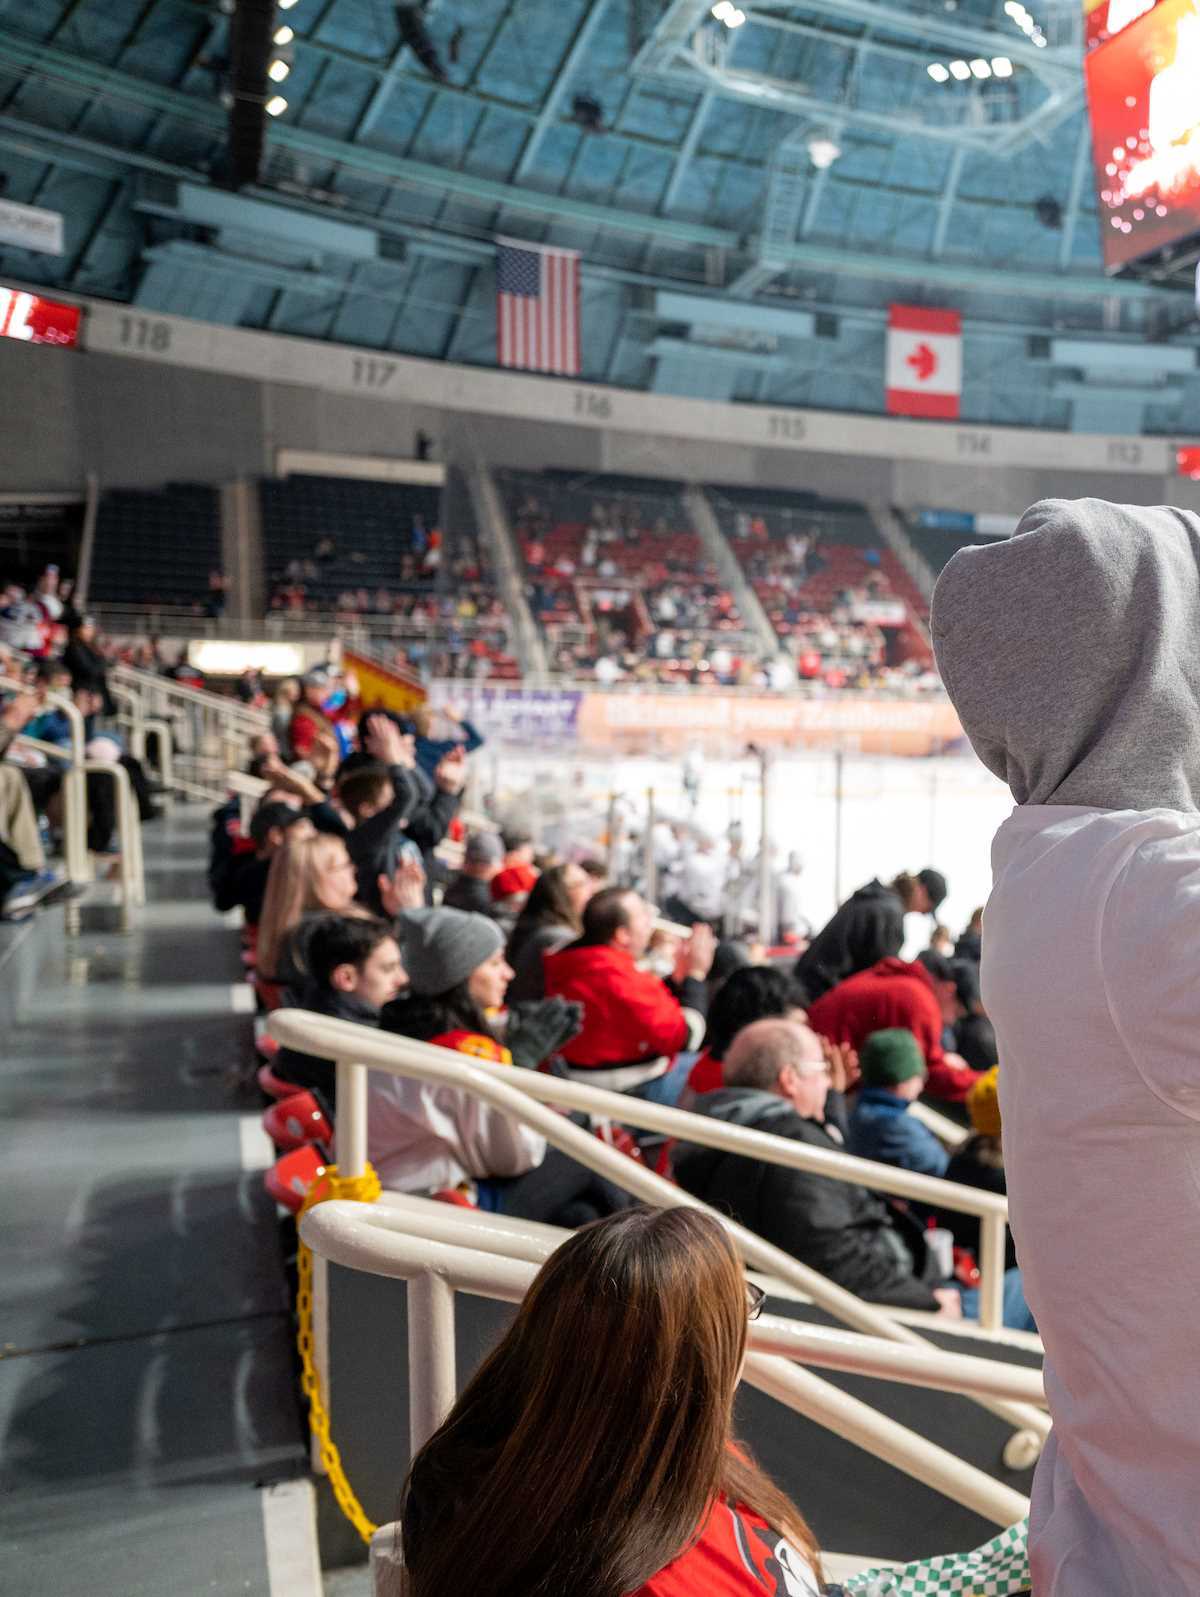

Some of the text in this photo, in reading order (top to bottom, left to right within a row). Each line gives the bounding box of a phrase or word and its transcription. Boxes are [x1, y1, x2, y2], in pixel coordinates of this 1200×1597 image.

[120, 315, 171, 352] 118
[352, 358, 397, 387] 117
[573, 390, 612, 418] 116
